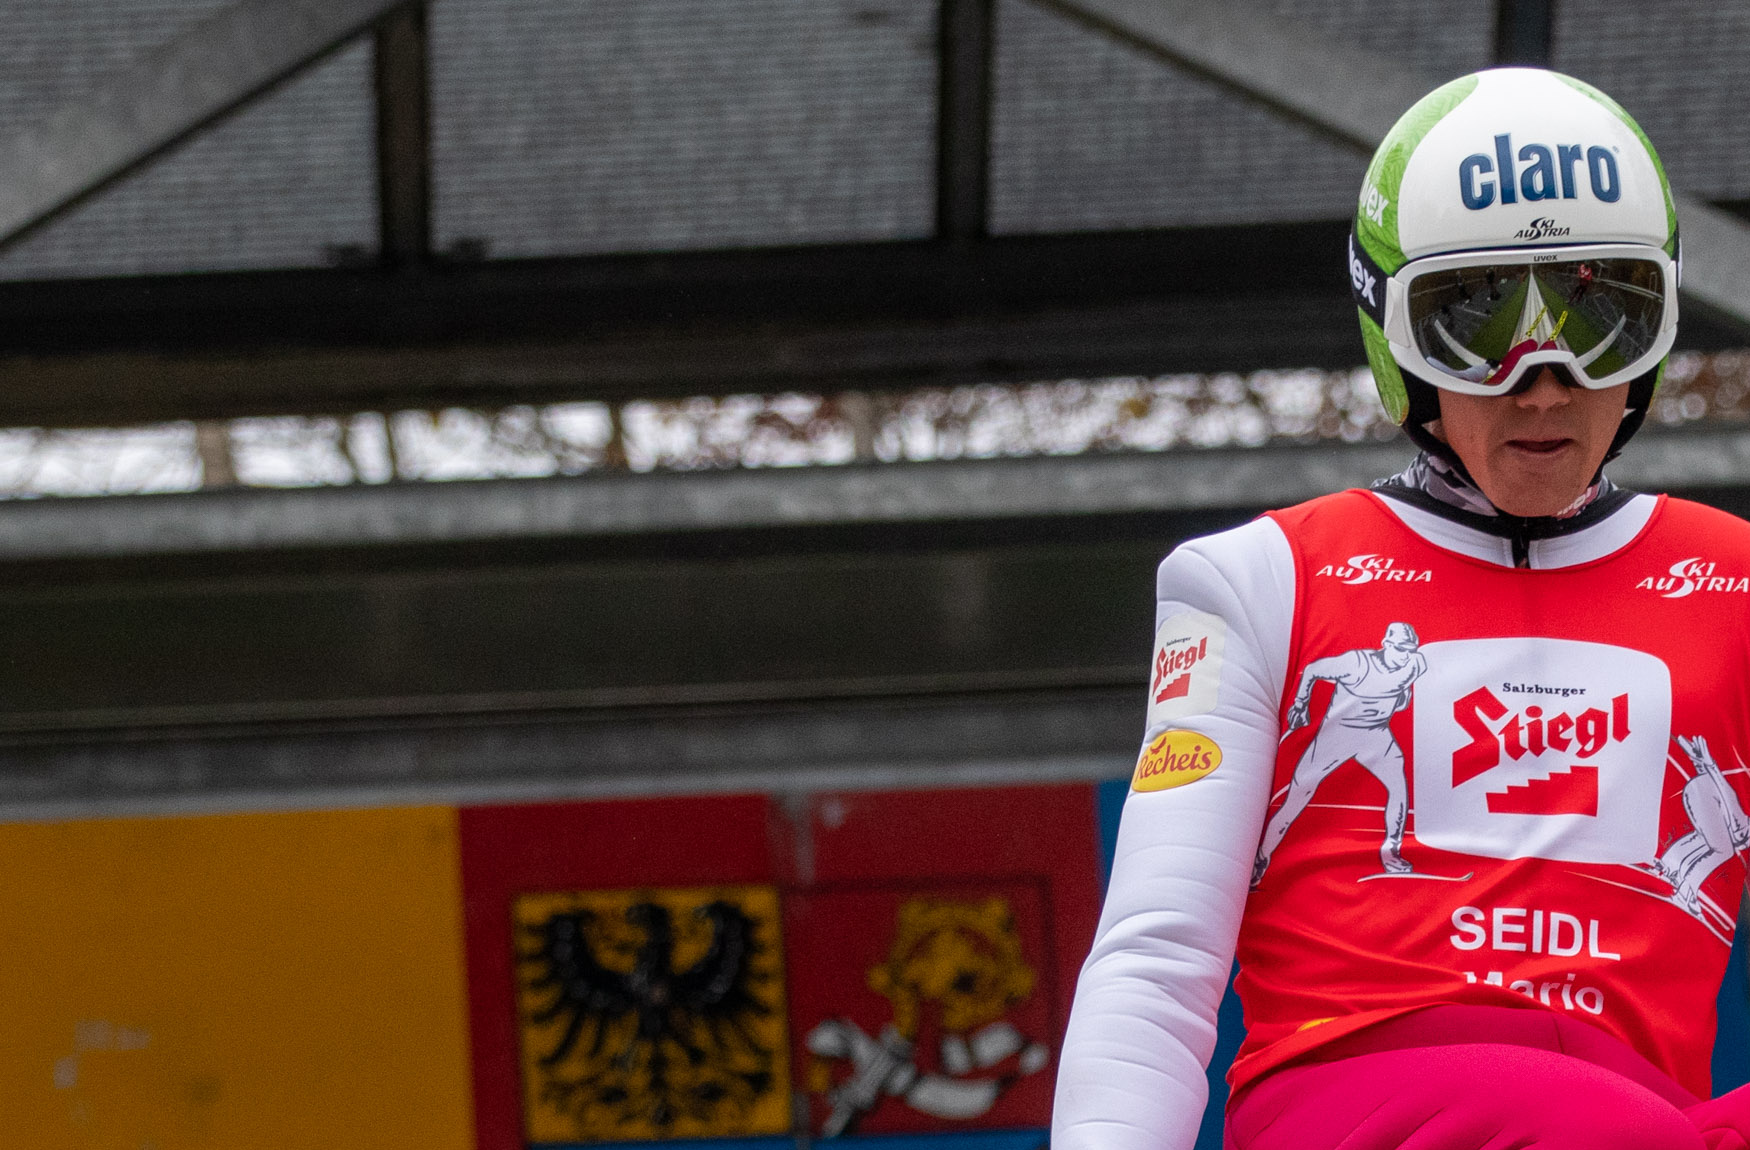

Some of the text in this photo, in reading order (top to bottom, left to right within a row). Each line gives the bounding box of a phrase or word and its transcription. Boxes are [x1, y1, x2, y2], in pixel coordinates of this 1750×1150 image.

[1459, 133, 1622, 211] claro
[1514, 226, 1570, 240] AUSTRIA
[1533, 254, 1558, 262] uvex
[1316, 562, 1433, 584] AUSTRIA
[1636, 575, 1750, 598] AUSTRIA
[1152, 636, 1208, 697] Stiegl
[1502, 682, 1587, 697] Salzburger
[1452, 686, 1632, 789] Stiegl
[1135, 744, 1212, 783] Recheis
[1450, 906, 1621, 961] SEIDL
